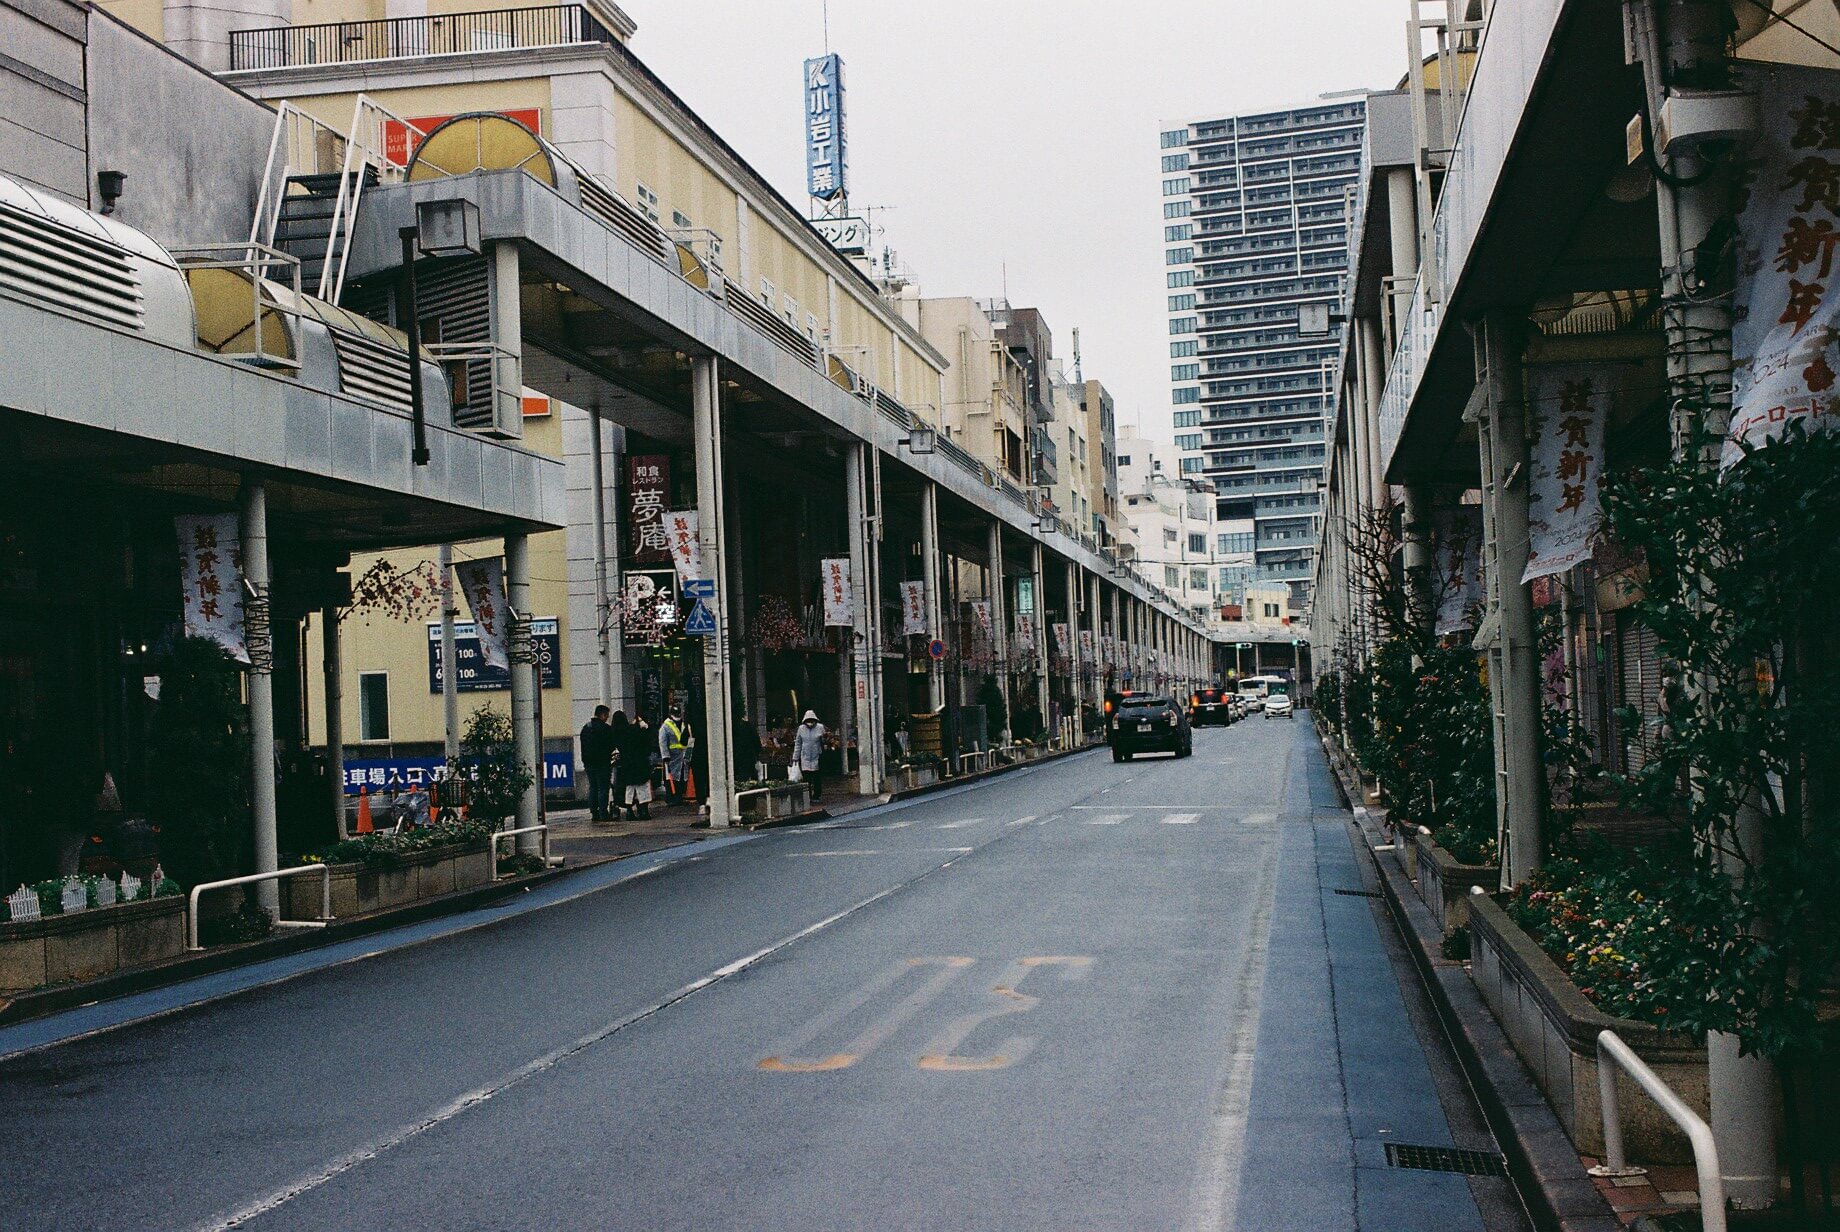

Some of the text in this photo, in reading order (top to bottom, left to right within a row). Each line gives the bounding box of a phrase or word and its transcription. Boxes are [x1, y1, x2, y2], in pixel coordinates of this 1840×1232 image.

[1555, 376, 1595, 516] 謹賀新年
[632, 476, 664, 485] レストラン
[636, 466, 660, 477] 和食
[631, 488, 669, 555] 夢庵
[627, 575, 656, 611] P
